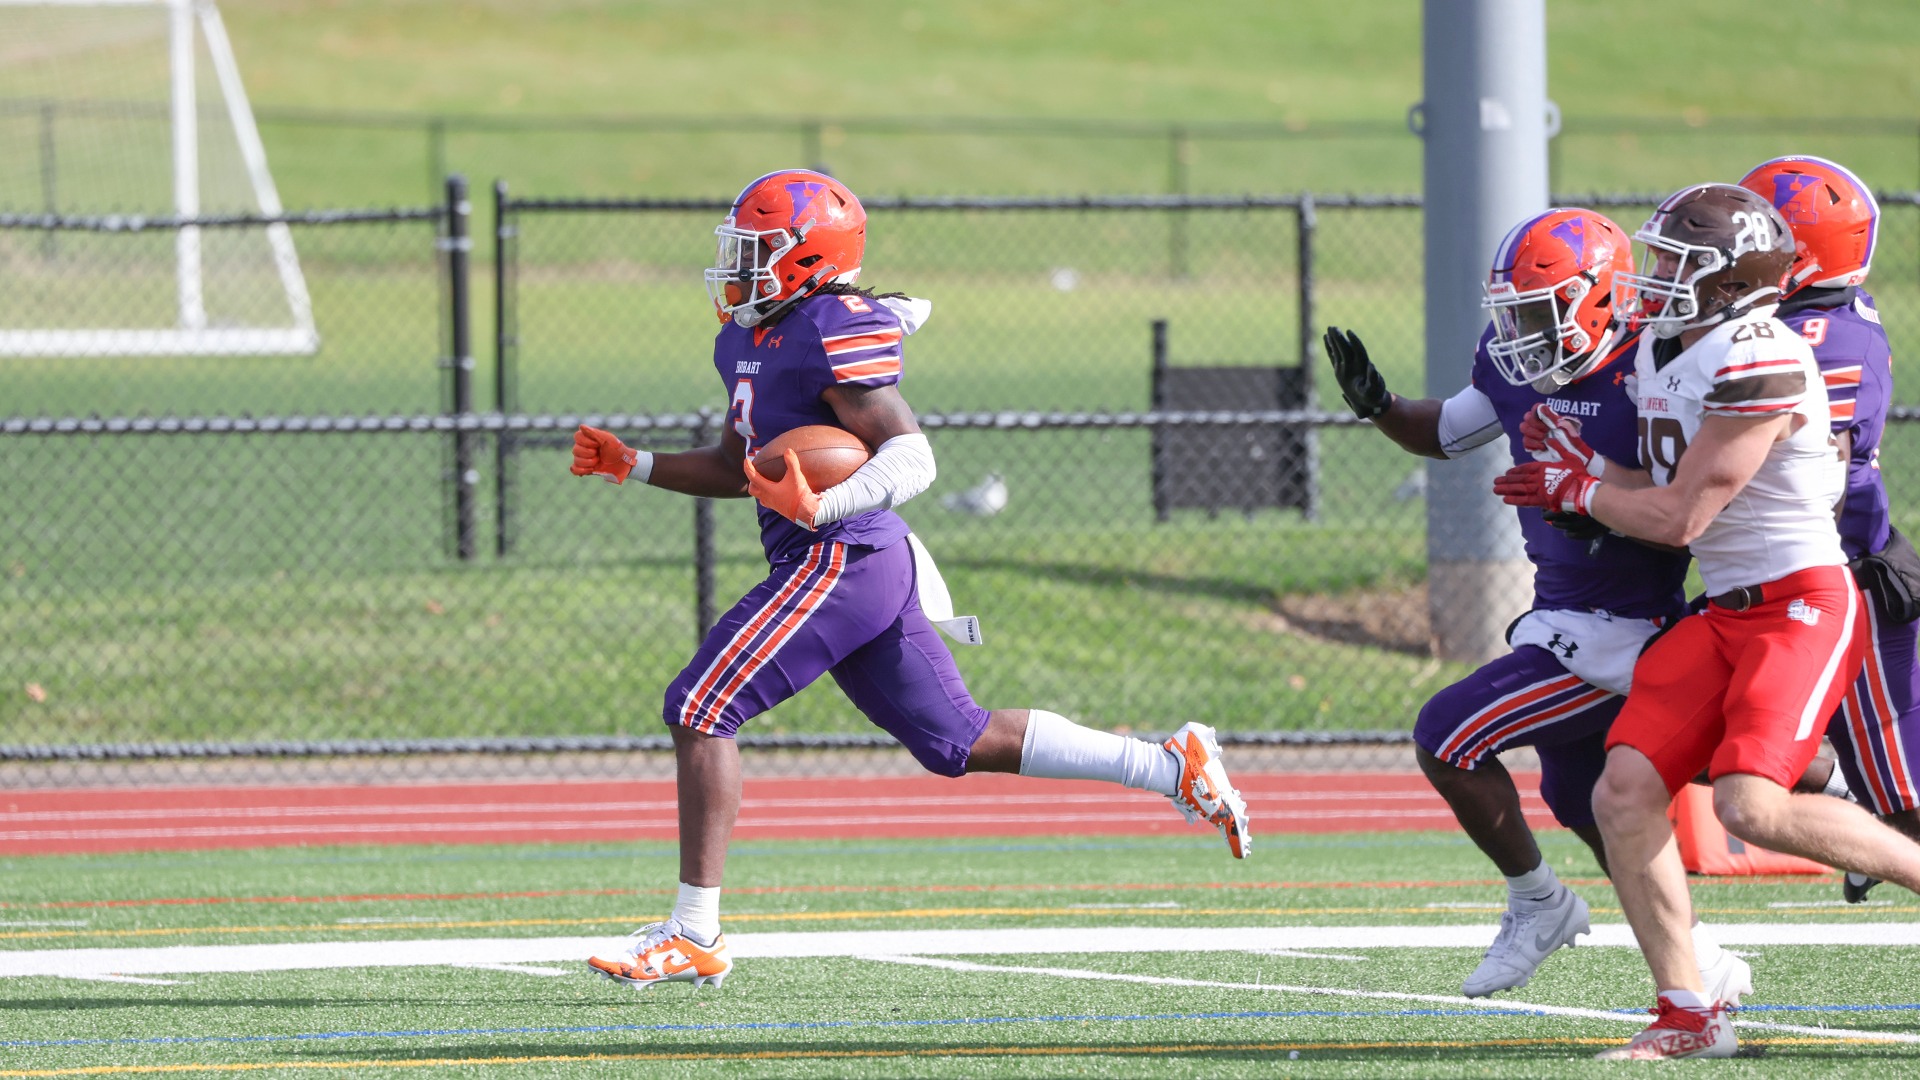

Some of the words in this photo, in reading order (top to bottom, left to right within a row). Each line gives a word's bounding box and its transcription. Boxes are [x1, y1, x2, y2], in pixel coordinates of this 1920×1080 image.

[1732, 211, 1771, 252] 28
[837, 295, 873, 313] 2
[1731, 321, 1775, 344] 28
[1802, 318, 1829, 347] 9
[735, 361, 761, 374] HOBART
[1546, 398, 1601, 416] HOBART
[1547, 468, 1572, 495] adidas
